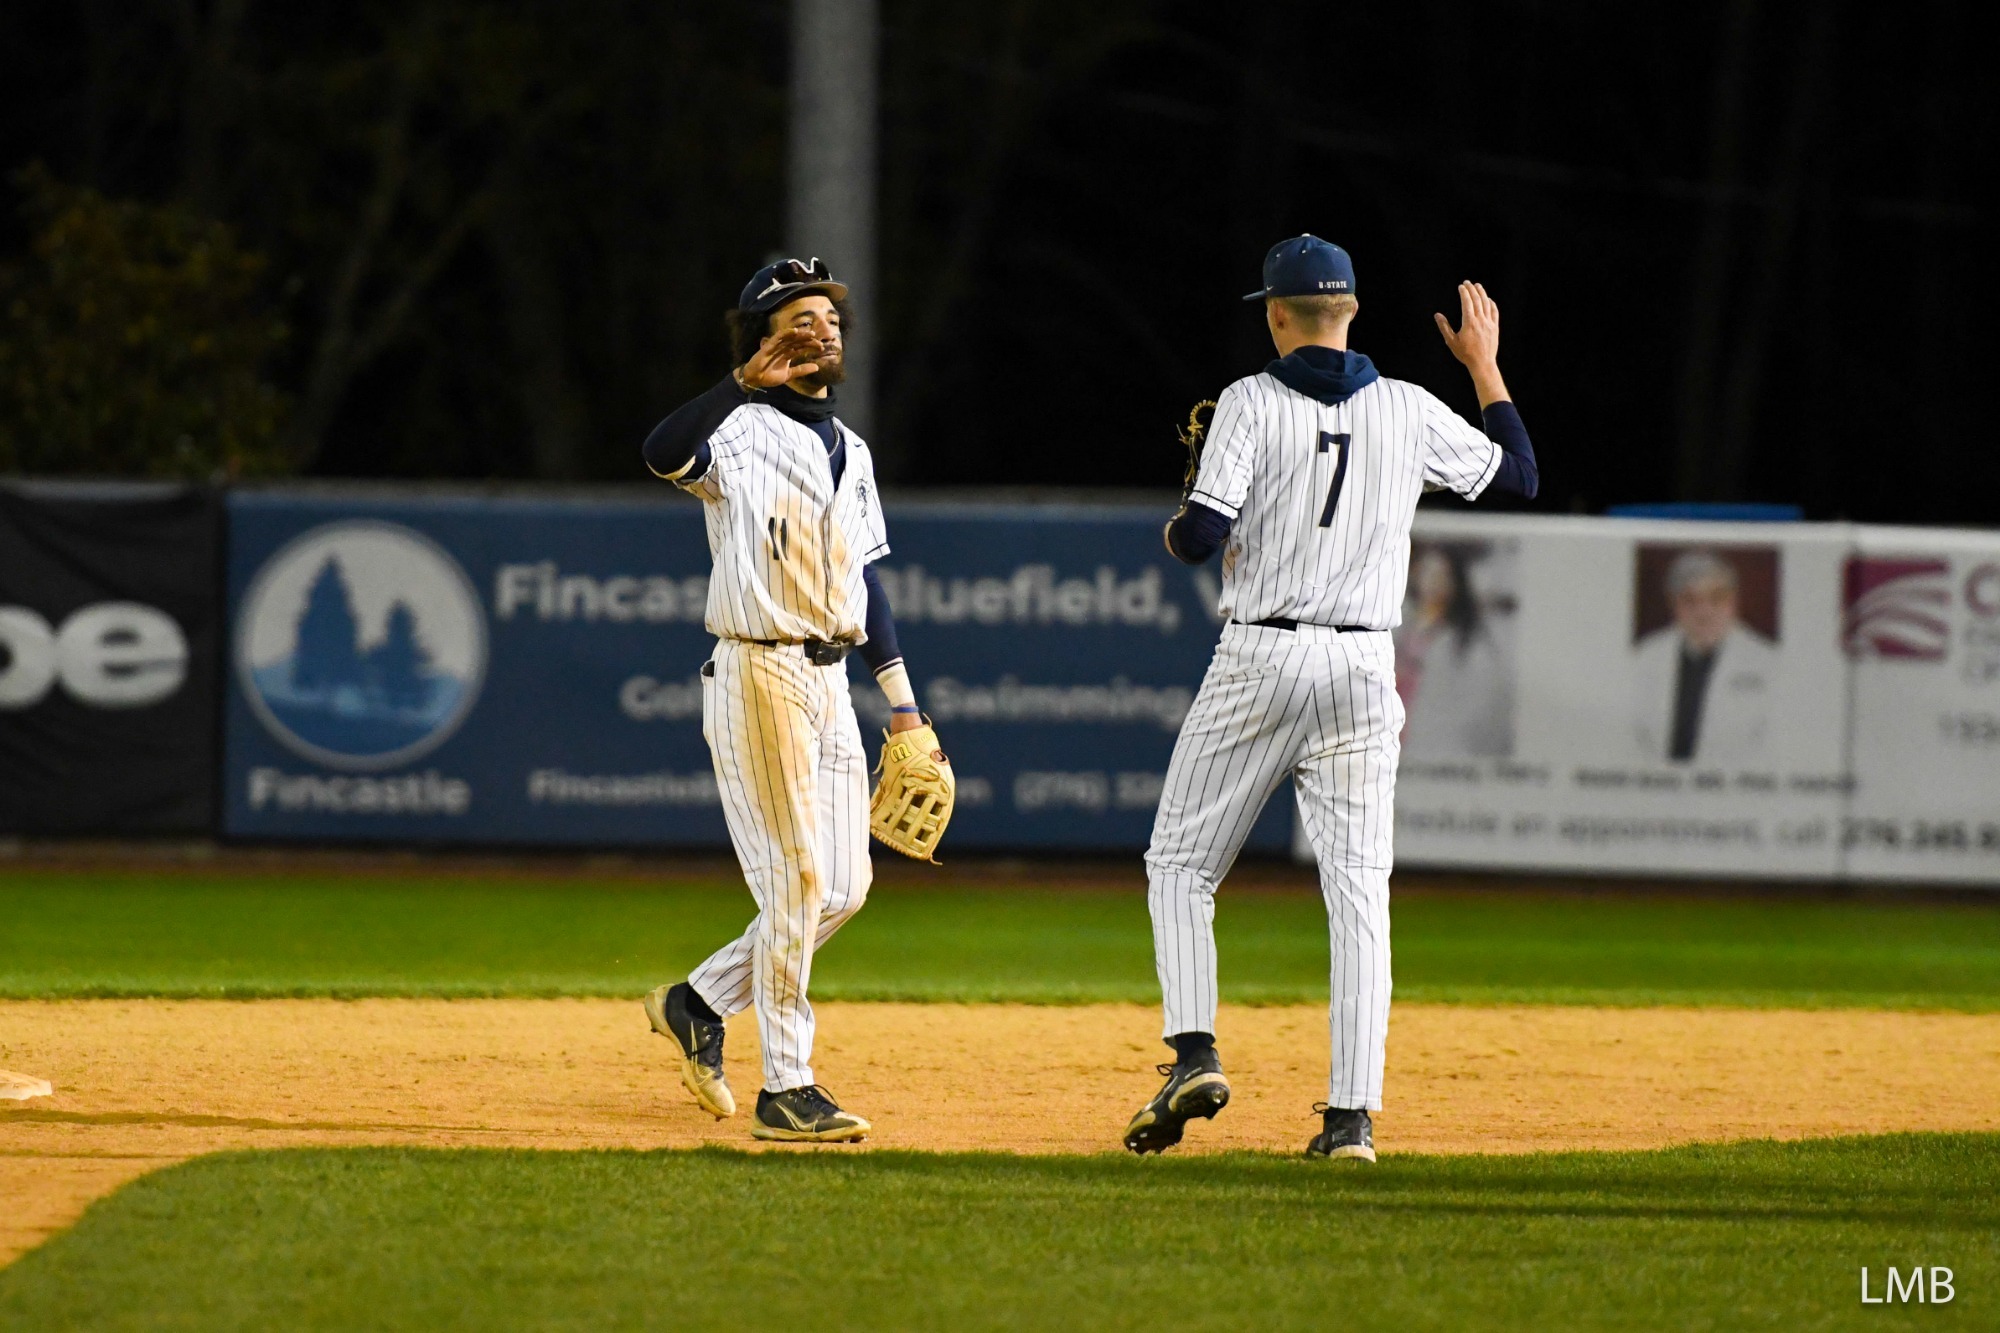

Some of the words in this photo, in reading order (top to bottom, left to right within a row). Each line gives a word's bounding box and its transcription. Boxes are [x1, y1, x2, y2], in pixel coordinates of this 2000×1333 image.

[1318, 430, 1351, 528] 7
[768, 516, 789, 561] 11
[248, 767, 473, 815] Fincastle
